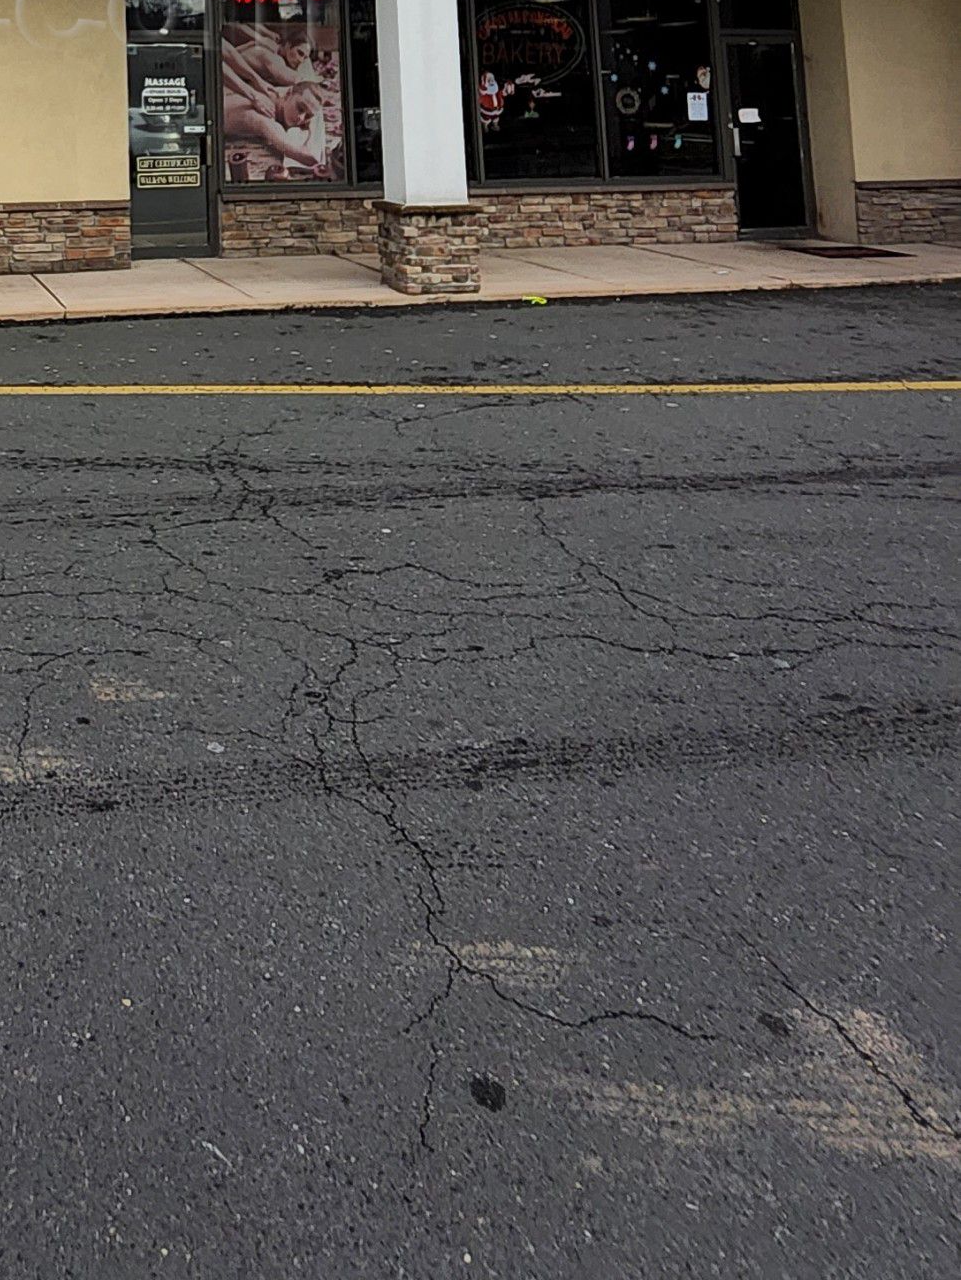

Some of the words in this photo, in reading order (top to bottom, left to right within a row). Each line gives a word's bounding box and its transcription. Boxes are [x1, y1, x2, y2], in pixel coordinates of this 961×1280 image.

[482, 42, 566, 65] BAKERY
[144, 77, 186, 87] MASSAGE
[139, 160, 154, 168] GIFT
